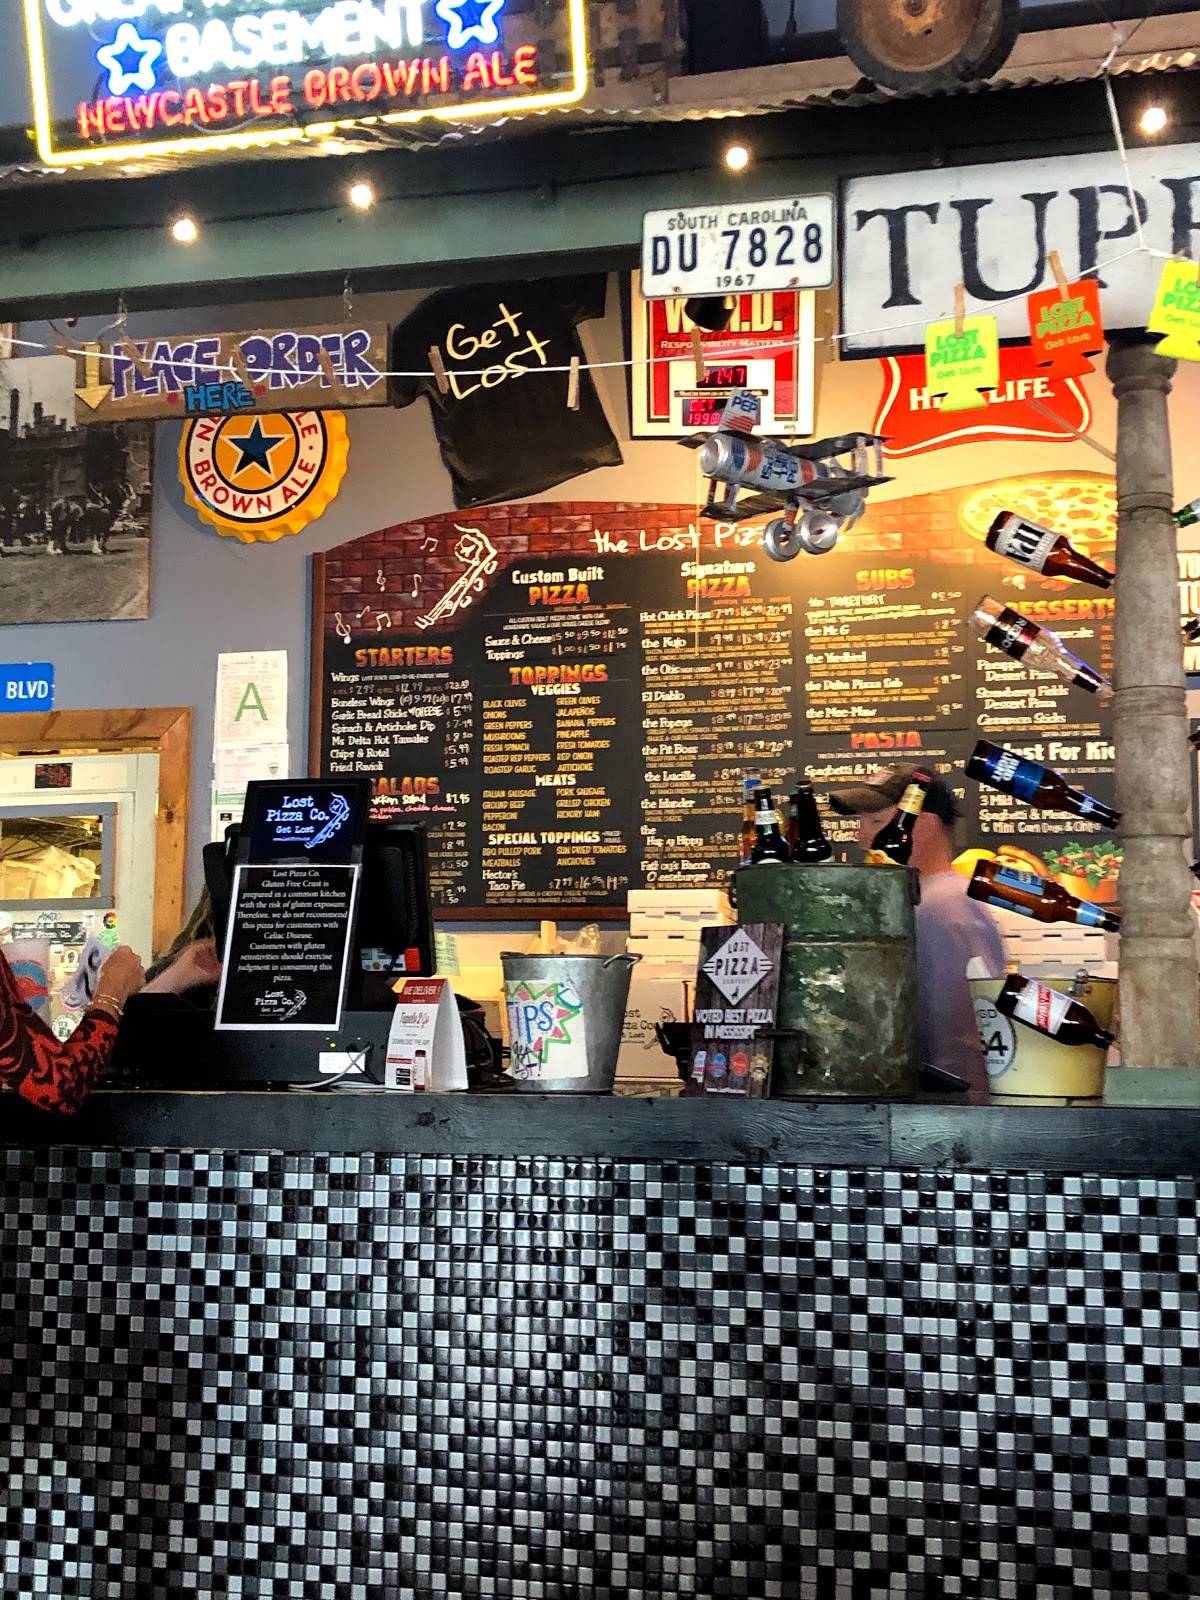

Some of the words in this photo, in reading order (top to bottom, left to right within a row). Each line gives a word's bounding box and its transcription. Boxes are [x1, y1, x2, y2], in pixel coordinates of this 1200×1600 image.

[165, 0, 422, 78] BASEMENT
[77, 75, 293, 139] NEWCASTLE
[303, 55, 450, 107] BROWN
[463, 44, 538, 91] ALE
[667, 212, 718, 232] SOUTH
[726, 206, 808, 227] CAROLINA
[651, 232, 698, 276] DU
[721, 222, 823, 271] 7828
[715, 274, 756, 288] 1967
[1040, 297, 1085, 321] LOST
[445, 302, 523, 361] Get
[1035, 312, 1096, 339] PIZZA
[935, 329, 980, 351] LOST
[930, 342, 987, 367] PIZZA
[110, 338, 221, 401] PLACE
[230, 329, 385, 391] ORDER
[446, 333, 551, 400] Lost
[184, 381, 256, 413] HERE
[193, 458, 272, 514] BROWN
[281, 457, 317, 504] ALE
[588, 529, 629, 553] the
[639, 524, 702, 551] Lost
[511, 570, 564, 584] Custom
[567, 566, 604, 582] Built
[680, 560, 756, 579] Signature
[855, 568, 915, 590] SUBS
[528, 583, 590, 605] PIZZA
[686, 575, 751, 598] PIZZA
[485, 636, 511, 646] Sauce
[354, 645, 453, 668] STARTERS
[485, 649, 525, 661] Toppings
[331, 672, 360, 683] Wings
[509, 664, 608, 685] TOPPINGS
[6, 680, 49, 700] BLVD
[531, 683, 581, 696] VEGGIES
[235, 682, 268, 721] A
[331, 697, 368, 708] Boneless
[369, 696, 395, 707] Wings
[331, 710, 355, 720] Garlic
[357, 708, 382, 719] Bread
[383, 708, 408, 719] Sticks
[331, 723, 362, 734] Spinach
[364, 722, 373, 732] &
[375, 721, 417, 732] Artichoke
[420, 720, 436, 732] Dip
[348, 736, 371, 745] Delta
[374, 735, 390, 745] Hot
[393, 734, 429, 744] Tamales
[330, 749, 354, 760] Chips
[356, 749, 364, 758] &
[366, 748, 390, 758] Rotel
[1048, 742, 1081, 760] For
[330, 762, 353, 772] Fried
[355, 761, 384, 771] Ravioli
[535, 774, 577, 786] MEATS
[282, 795, 314, 809] Lost
[265, 809, 304, 822] Pizza
[309, 808, 330, 821] Co.
[275, 825, 292, 834] Get
[294, 825, 315, 834] Lost
[488, 832, 538, 845] SPECIAL
[540, 831, 601, 844] TOPPINGS
[482, 869, 518, 880] Hector's
[488, 880, 510, 891] Taco
[511, 880, 526, 890] Pie
[727, 941, 750, 954] LOST
[714, 957, 760, 976] PIZZA
